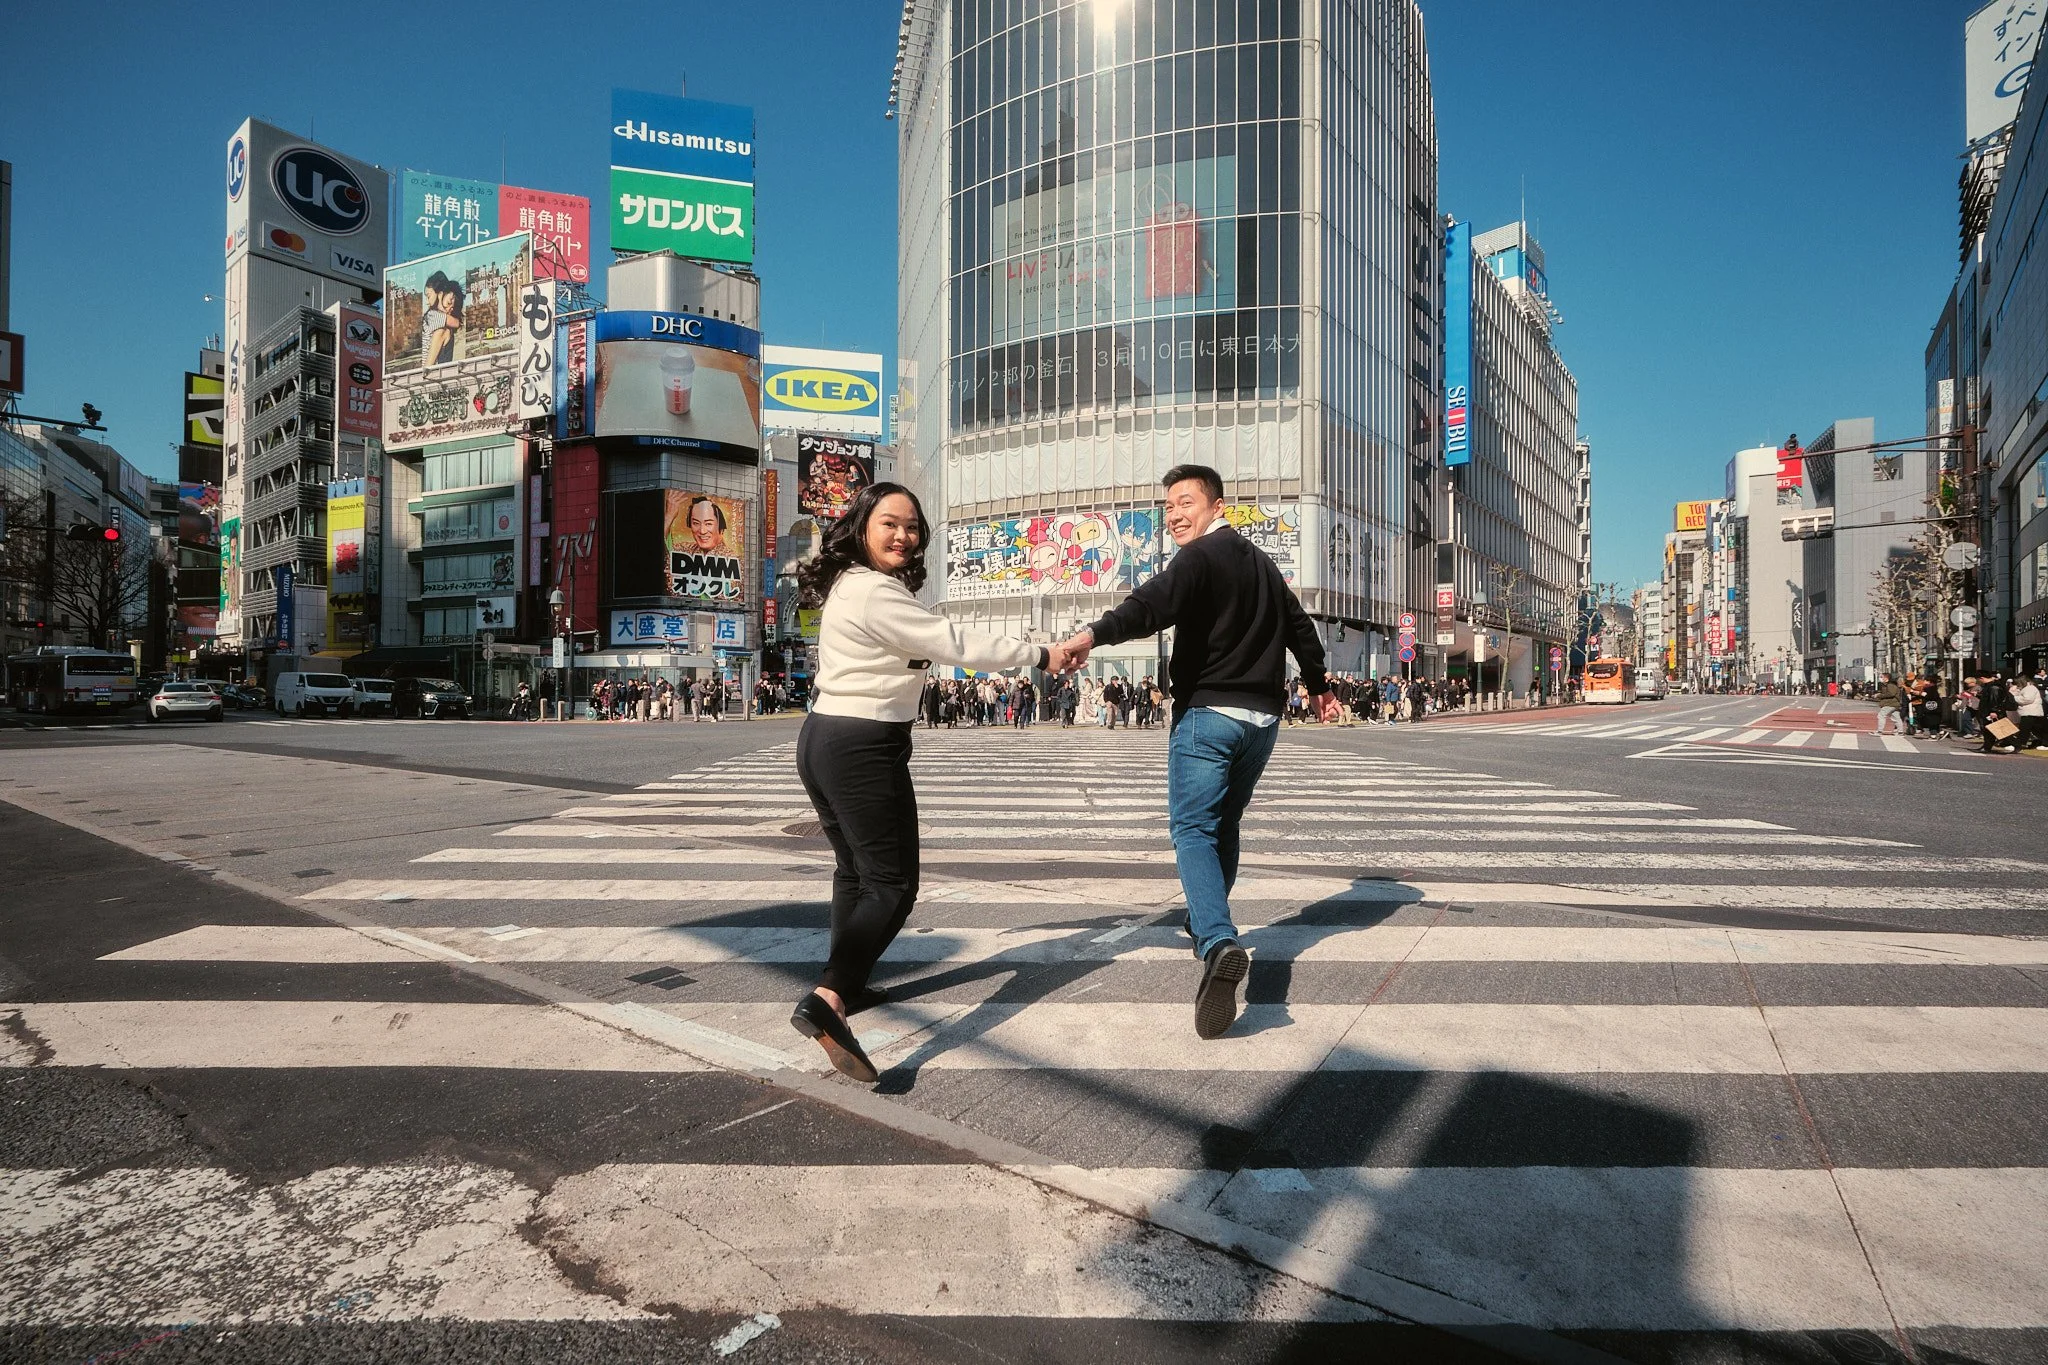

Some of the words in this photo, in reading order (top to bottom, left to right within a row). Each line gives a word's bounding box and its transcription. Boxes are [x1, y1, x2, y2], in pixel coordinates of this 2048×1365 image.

[614, 120, 750, 155] Hisamitsu
[286, 161, 360, 218] UC
[424, 192, 480, 221] 龍角散
[620, 193, 744, 238] サロンパス
[519, 207, 572, 234] 龍角散
[334, 251, 375, 276] VISA
[1008, 254, 1048, 280] LIVE
[1019, 282, 1045, 296] PRFECT
[652, 315, 702, 338] DHC
[522, 284, 552, 413] もんじゃ
[776, 378, 870, 402] IKEA
[1447, 385, 1466, 455] SEIBU
[653, 438, 671, 447] DHC
[671, 438, 701, 448] Channel
[800, 437, 872, 459] ダンジョン飯
[948, 526, 1009, 555] 常識を
[671, 552, 740, 580] DMM
[673, 577, 740, 598] オンクレ
[1793, 602, 1803, 629] ZARA
